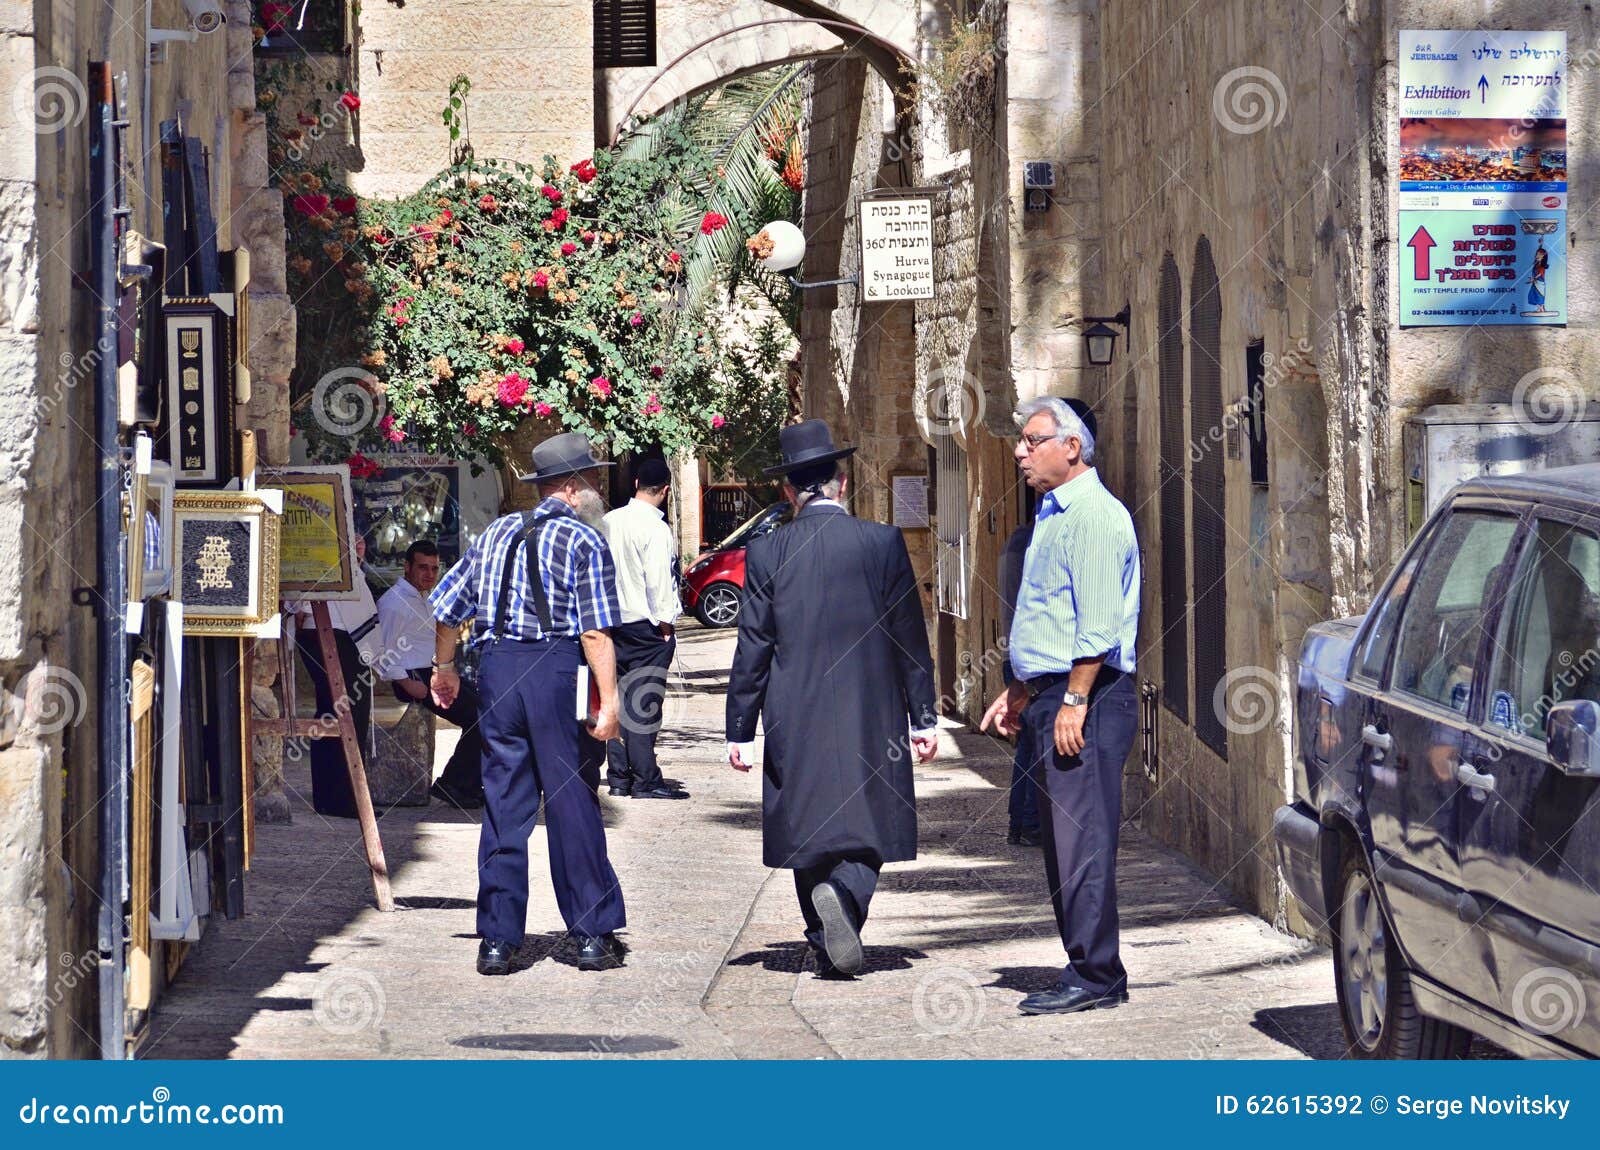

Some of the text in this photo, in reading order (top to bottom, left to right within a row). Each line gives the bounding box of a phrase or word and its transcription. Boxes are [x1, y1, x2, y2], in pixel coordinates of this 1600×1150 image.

[1472, 41, 1561, 60] ירושלים שלנו
[1410, 53, 1458, 61] JERUSALEM
[1501, 71, 1562, 87] לתערוכה
[1404, 85, 1471, 100] Exhibition
[1404, 107, 1433, 116] Sharon
[872, 205, 928, 216] בית כנסת
[885, 221, 929, 232] החורבה
[1472, 224, 1517, 236] המרכז
[888, 237, 929, 248] ותצפית
[1452, 238, 1517, 251] לתולדות
[895, 255, 930, 267] Hurva
[1454, 253, 1517, 267] ירושלים
[873, 270, 931, 282] Synagogue
[1483, 269, 1517, 280] בימי
[867, 284, 931, 297] & Lookout
